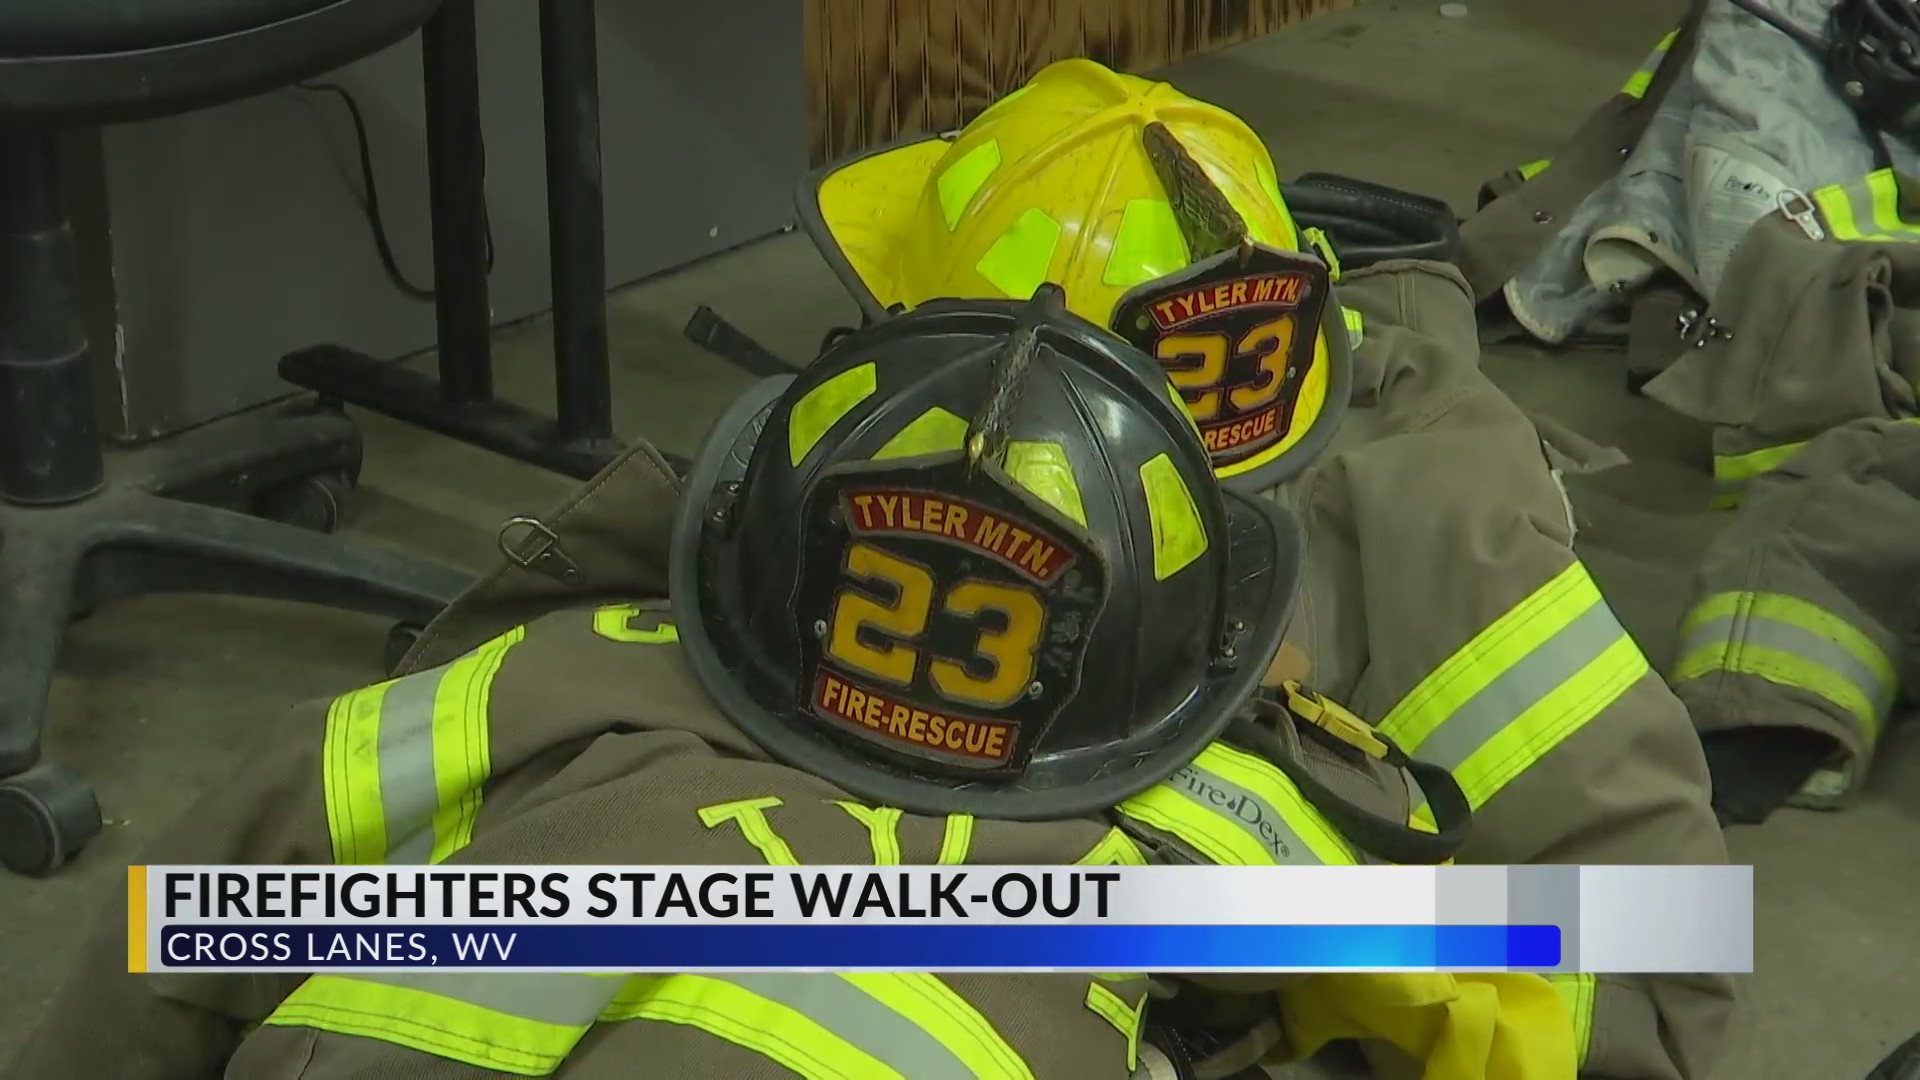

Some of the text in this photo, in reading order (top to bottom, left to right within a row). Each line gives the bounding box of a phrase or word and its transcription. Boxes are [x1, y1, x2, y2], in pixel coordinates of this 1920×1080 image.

[1156, 283, 1248, 323] TYLER
[1156, 313, 1295, 420] 23
[854, 495, 1055, 578] TYLER MTN.
[828, 542, 1045, 709] 23
[822, 677, 1007, 757] FIRE-RESCUE
